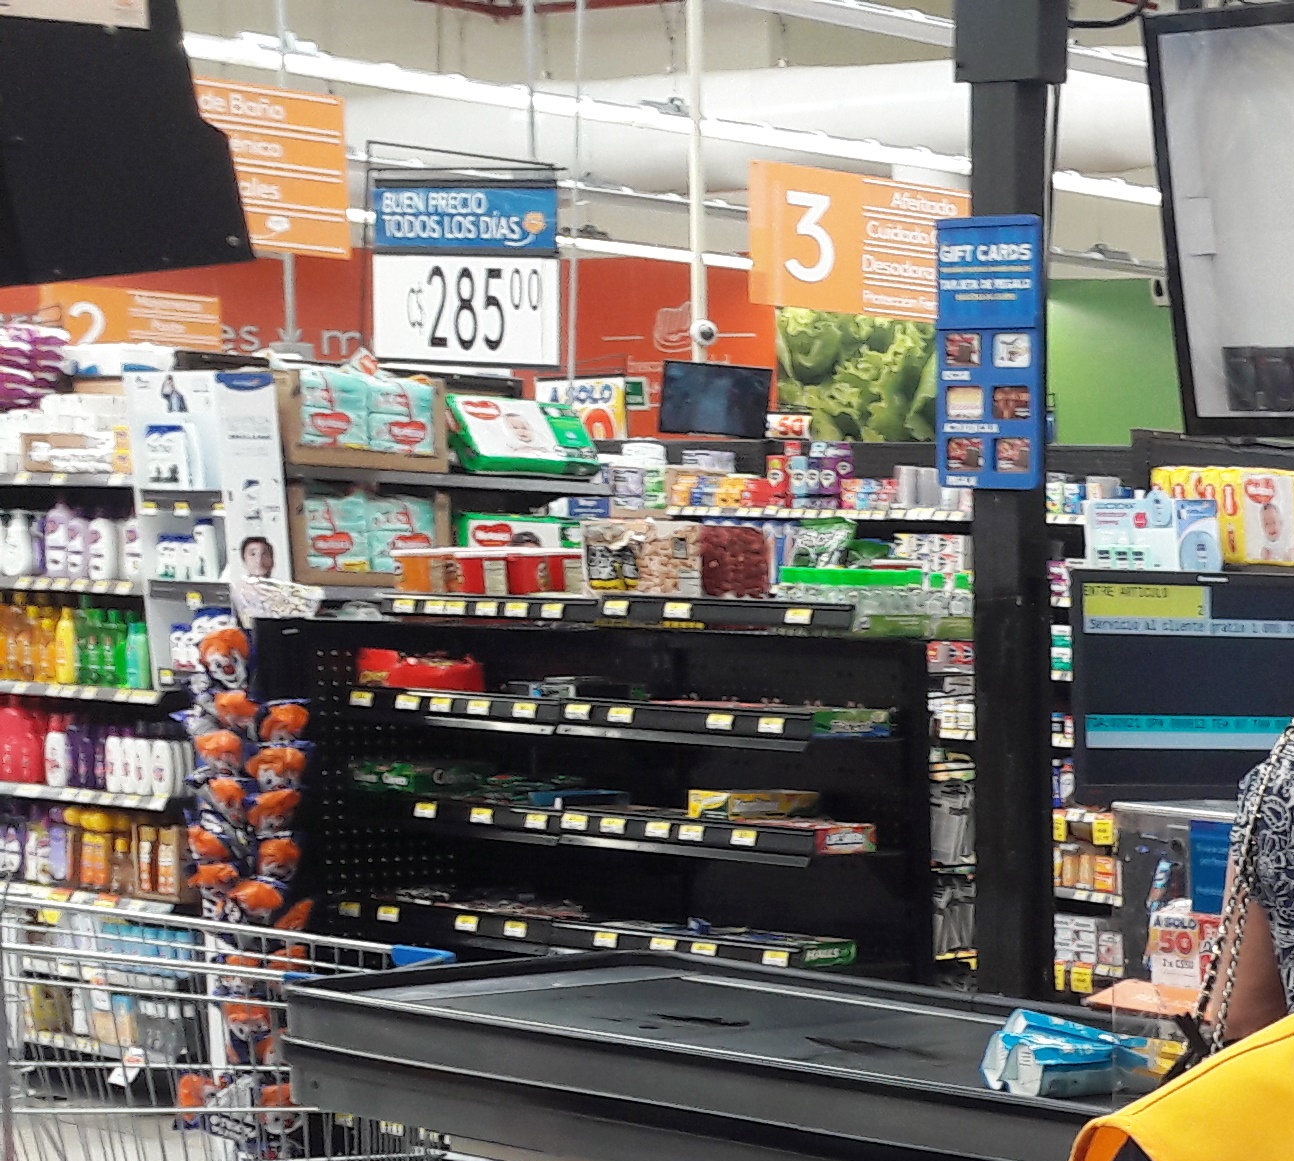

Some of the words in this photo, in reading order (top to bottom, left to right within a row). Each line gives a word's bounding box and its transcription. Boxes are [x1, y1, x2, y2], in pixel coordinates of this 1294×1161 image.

[382, 192, 426, 213] BUEN
[382, 215, 443, 238] TODOS
[444, 215, 479, 239] LOS
[480, 211, 523, 240] DÍAS
[784, 189, 836, 283] 3
[939, 244, 976, 262] GIFT
[976, 243, 1033, 262] CARDS
[861, 253, 938, 279] Desodora
[427, 265, 505, 351] 285
[69, 301, 107, 345] 2
[1164, 915, 1198, 930] SOLO
[1158, 930, 1194, 955] 50
